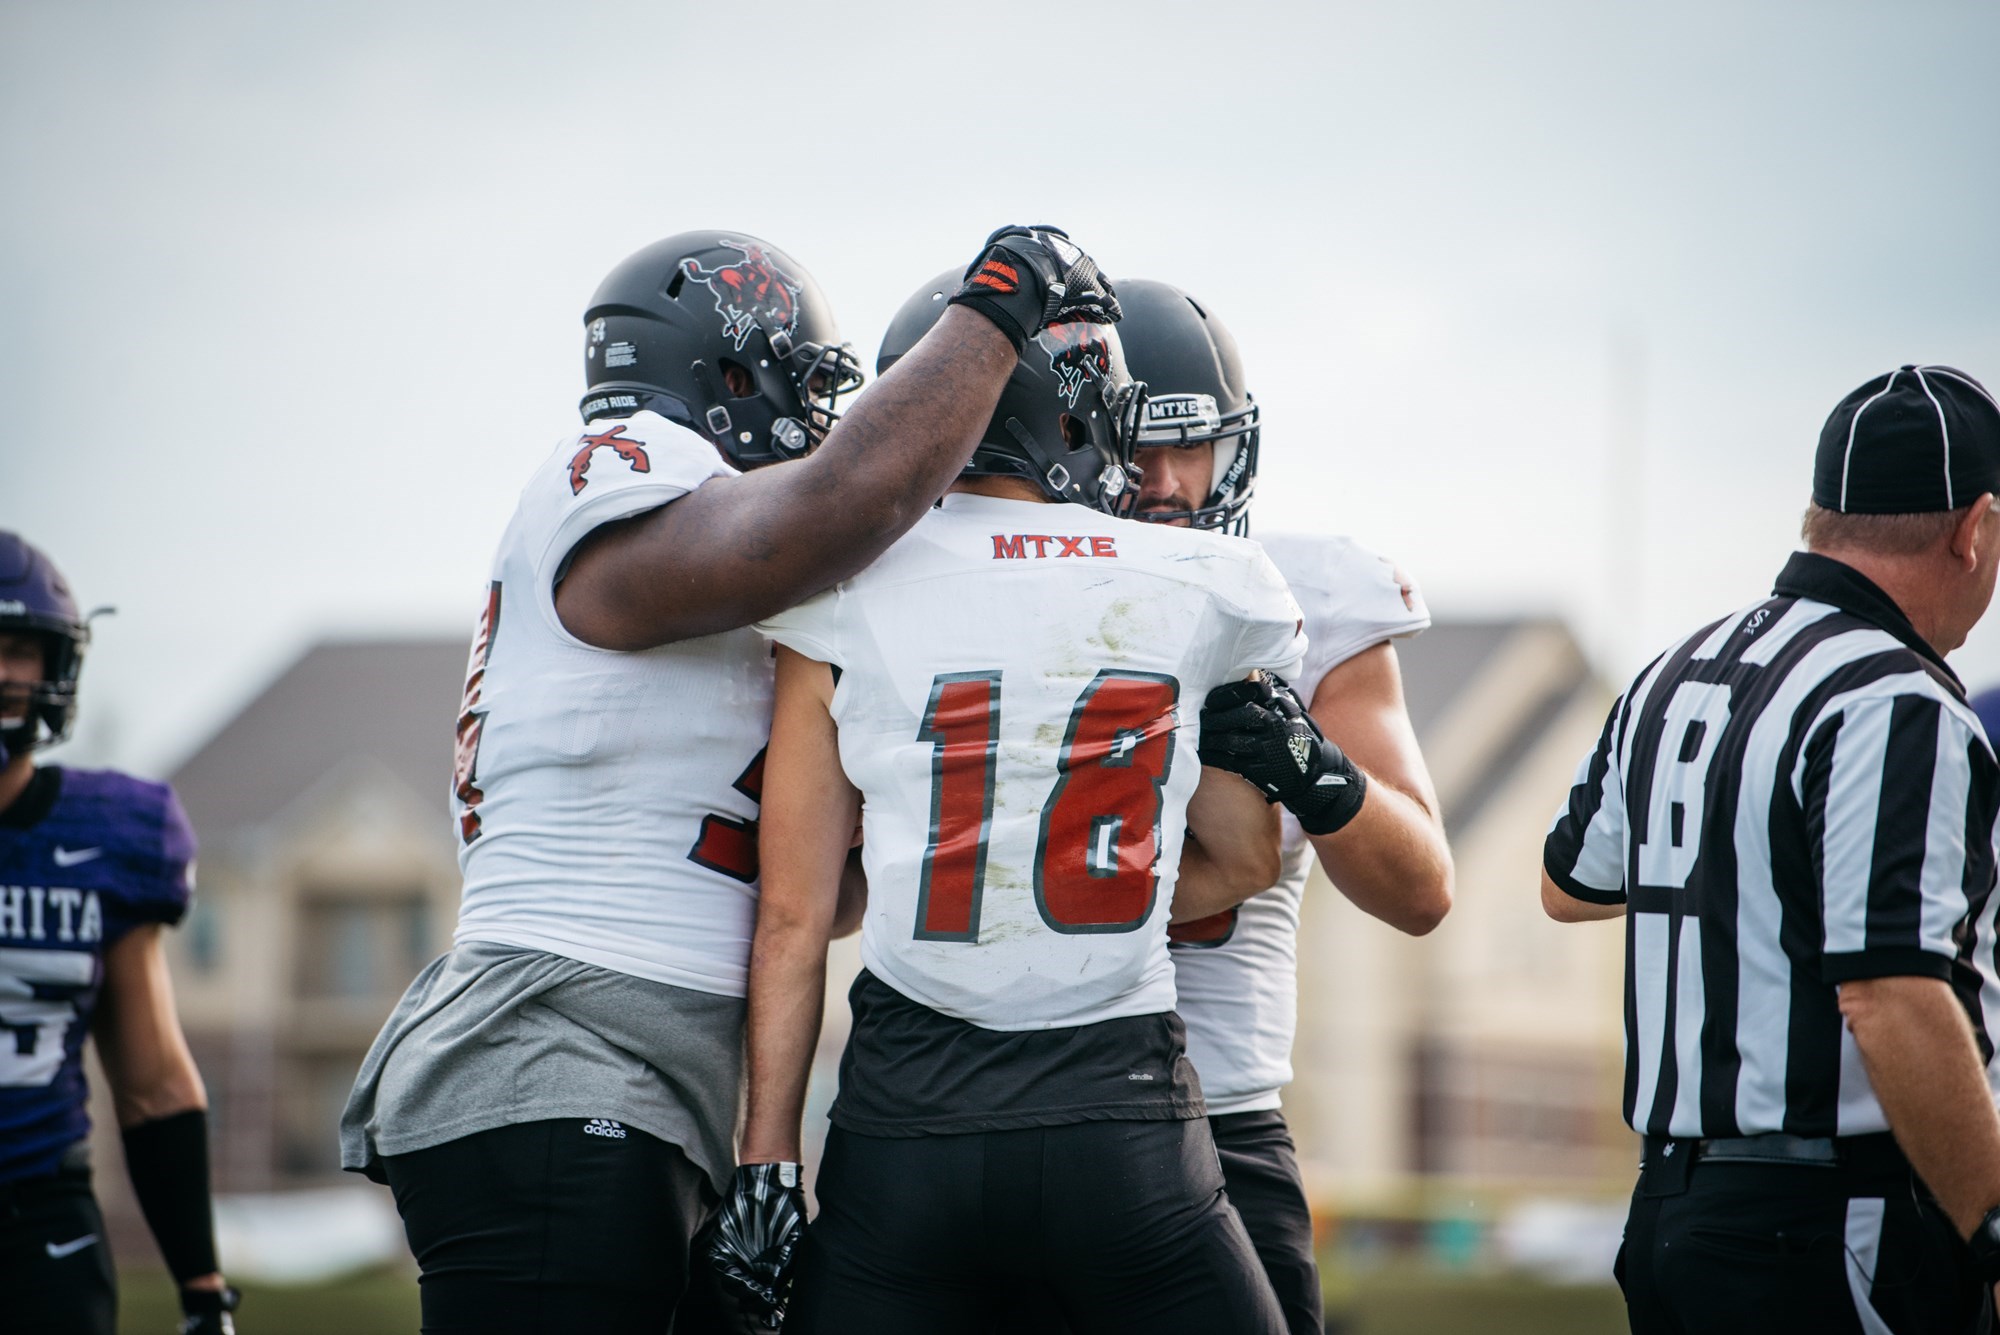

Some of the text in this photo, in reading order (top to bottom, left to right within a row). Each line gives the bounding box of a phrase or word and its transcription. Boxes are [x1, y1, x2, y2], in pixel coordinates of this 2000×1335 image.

[608, 395, 638, 408] RIDE
[1150, 400, 1199, 419] MTXE
[991, 534, 1118, 560] MTXE
[1287, 737, 1308, 774] adidas
[1638, 680, 1733, 889] B
[913, 668, 1181, 944] 18
[583, 1124, 626, 1139] adidas
